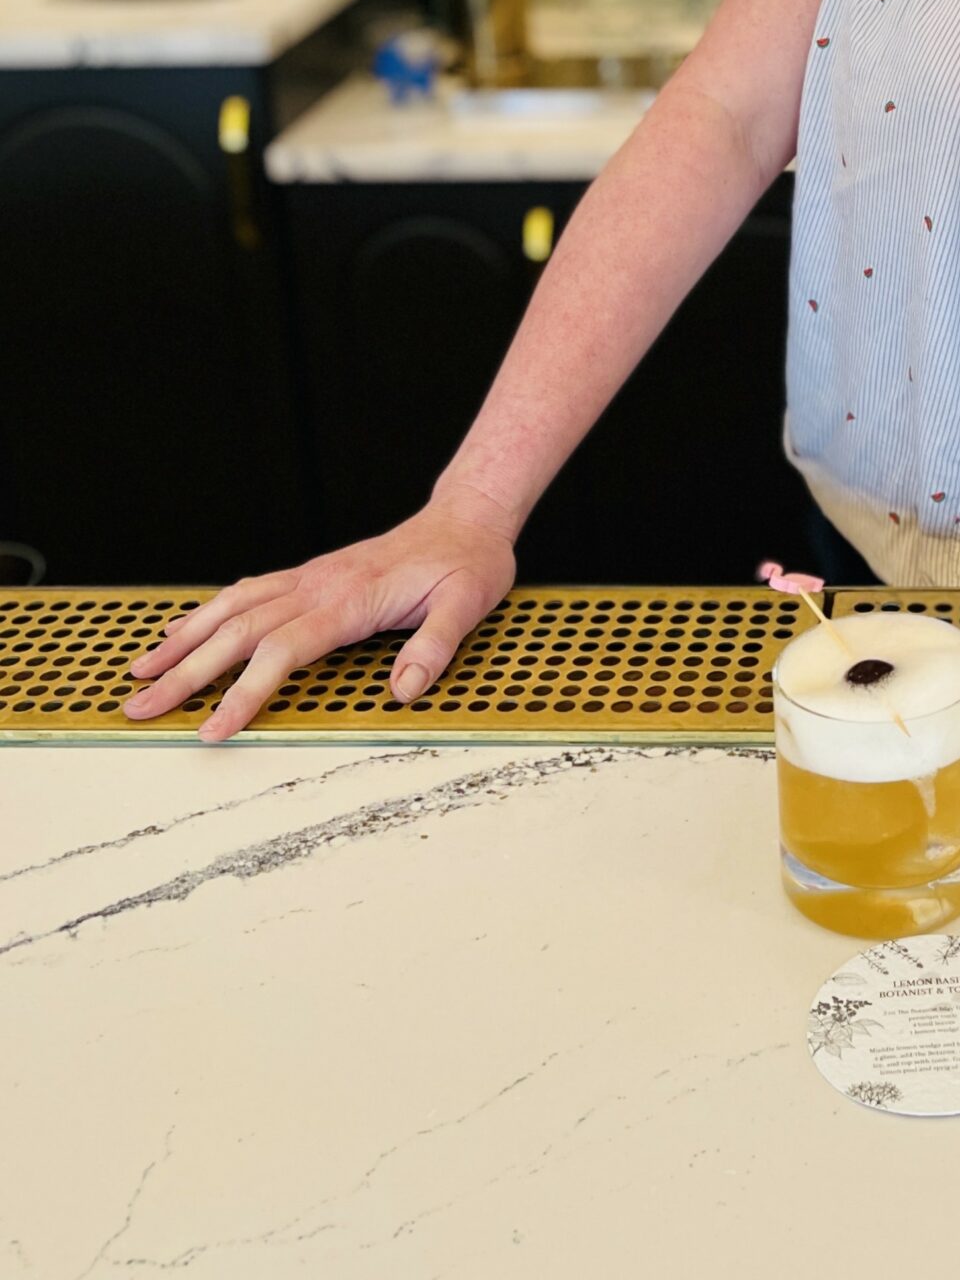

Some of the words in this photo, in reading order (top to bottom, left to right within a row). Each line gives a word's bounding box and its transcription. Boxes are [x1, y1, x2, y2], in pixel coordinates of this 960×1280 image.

[893, 977, 933, 988] LEMON
[879, 987, 932, 998] BOTANIST
[936, 987, 944, 995] &
